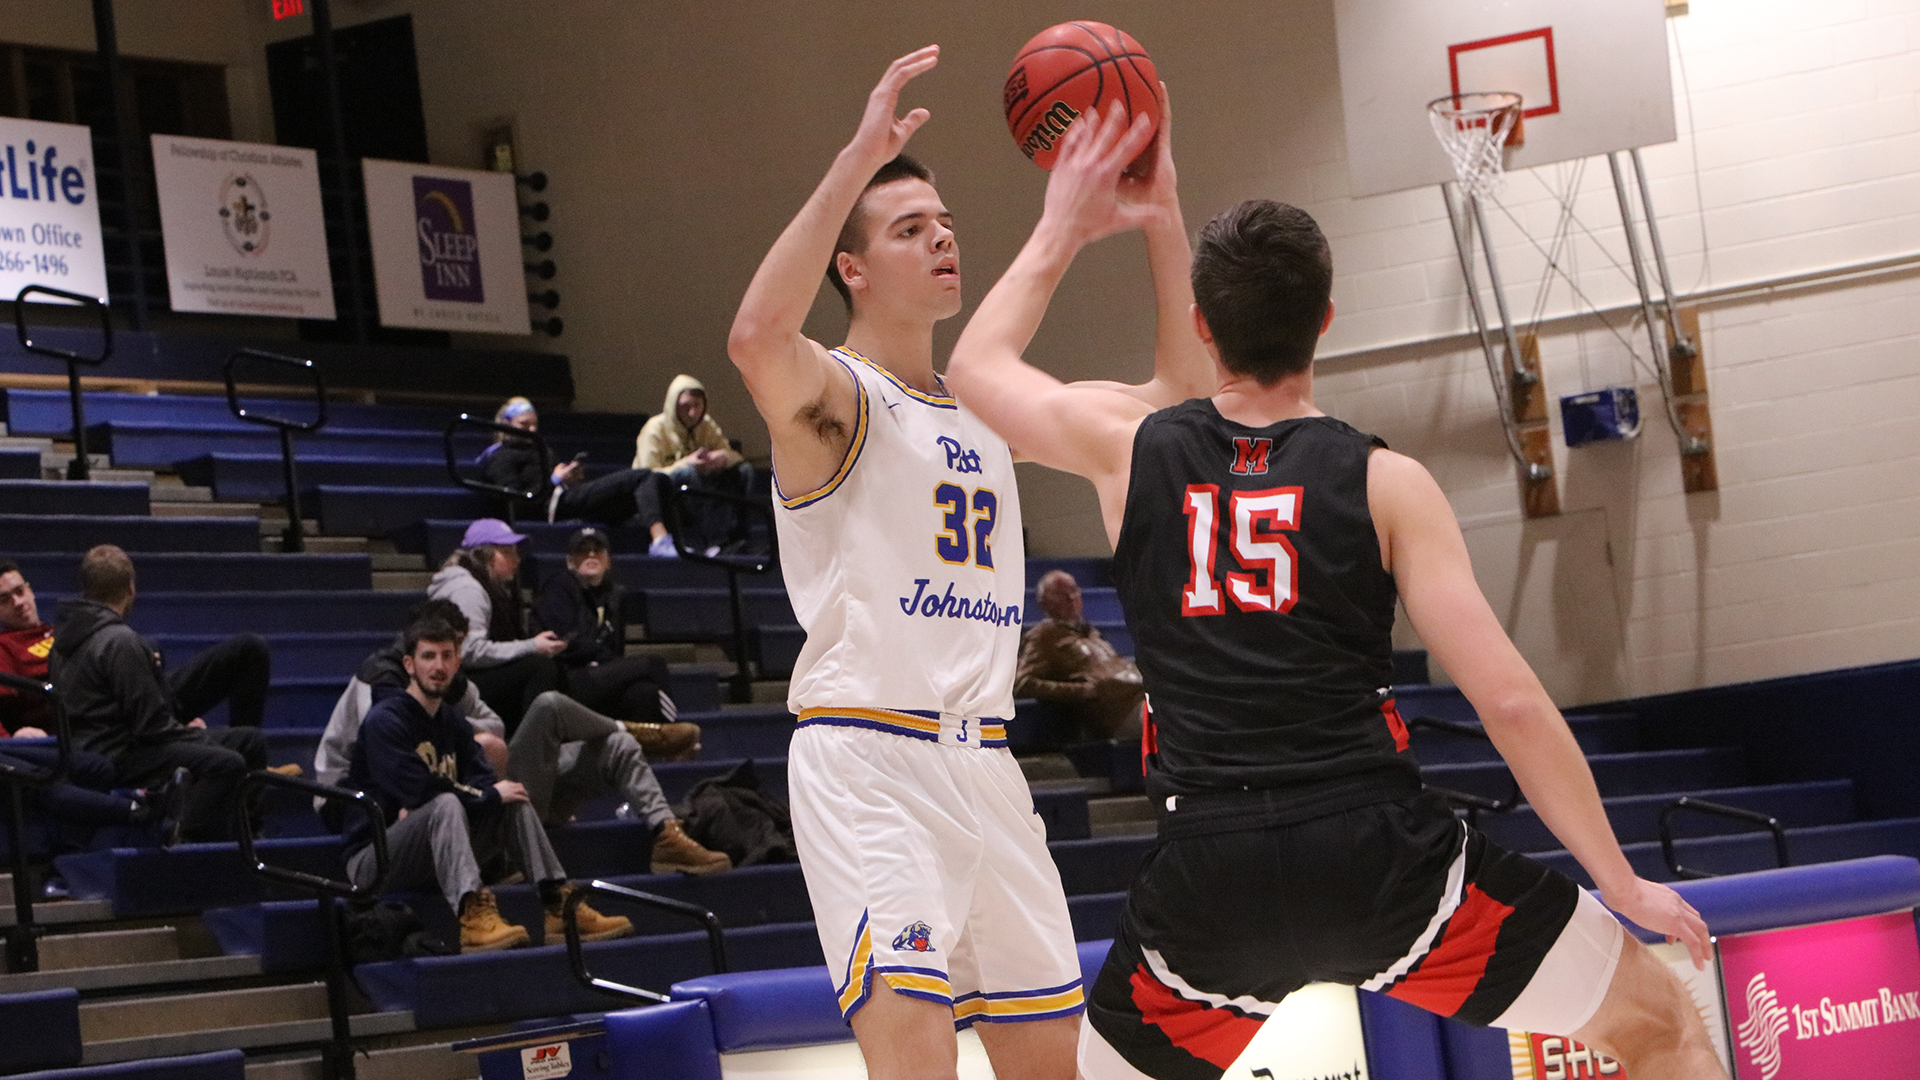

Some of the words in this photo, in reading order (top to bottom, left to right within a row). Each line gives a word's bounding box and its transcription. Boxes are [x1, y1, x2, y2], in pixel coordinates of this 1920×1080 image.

[0, 139, 86, 205] Life
[32, 222, 82, 248] Office
[436, 261, 471, 287] INN
[1230, 437, 1273, 475] M
[933, 480, 998, 573] 32
[1181, 483, 1304, 617] 15
[1820, 997, 1880, 1036] SUMMIT
[1878, 987, 1920, 1024] BANK
